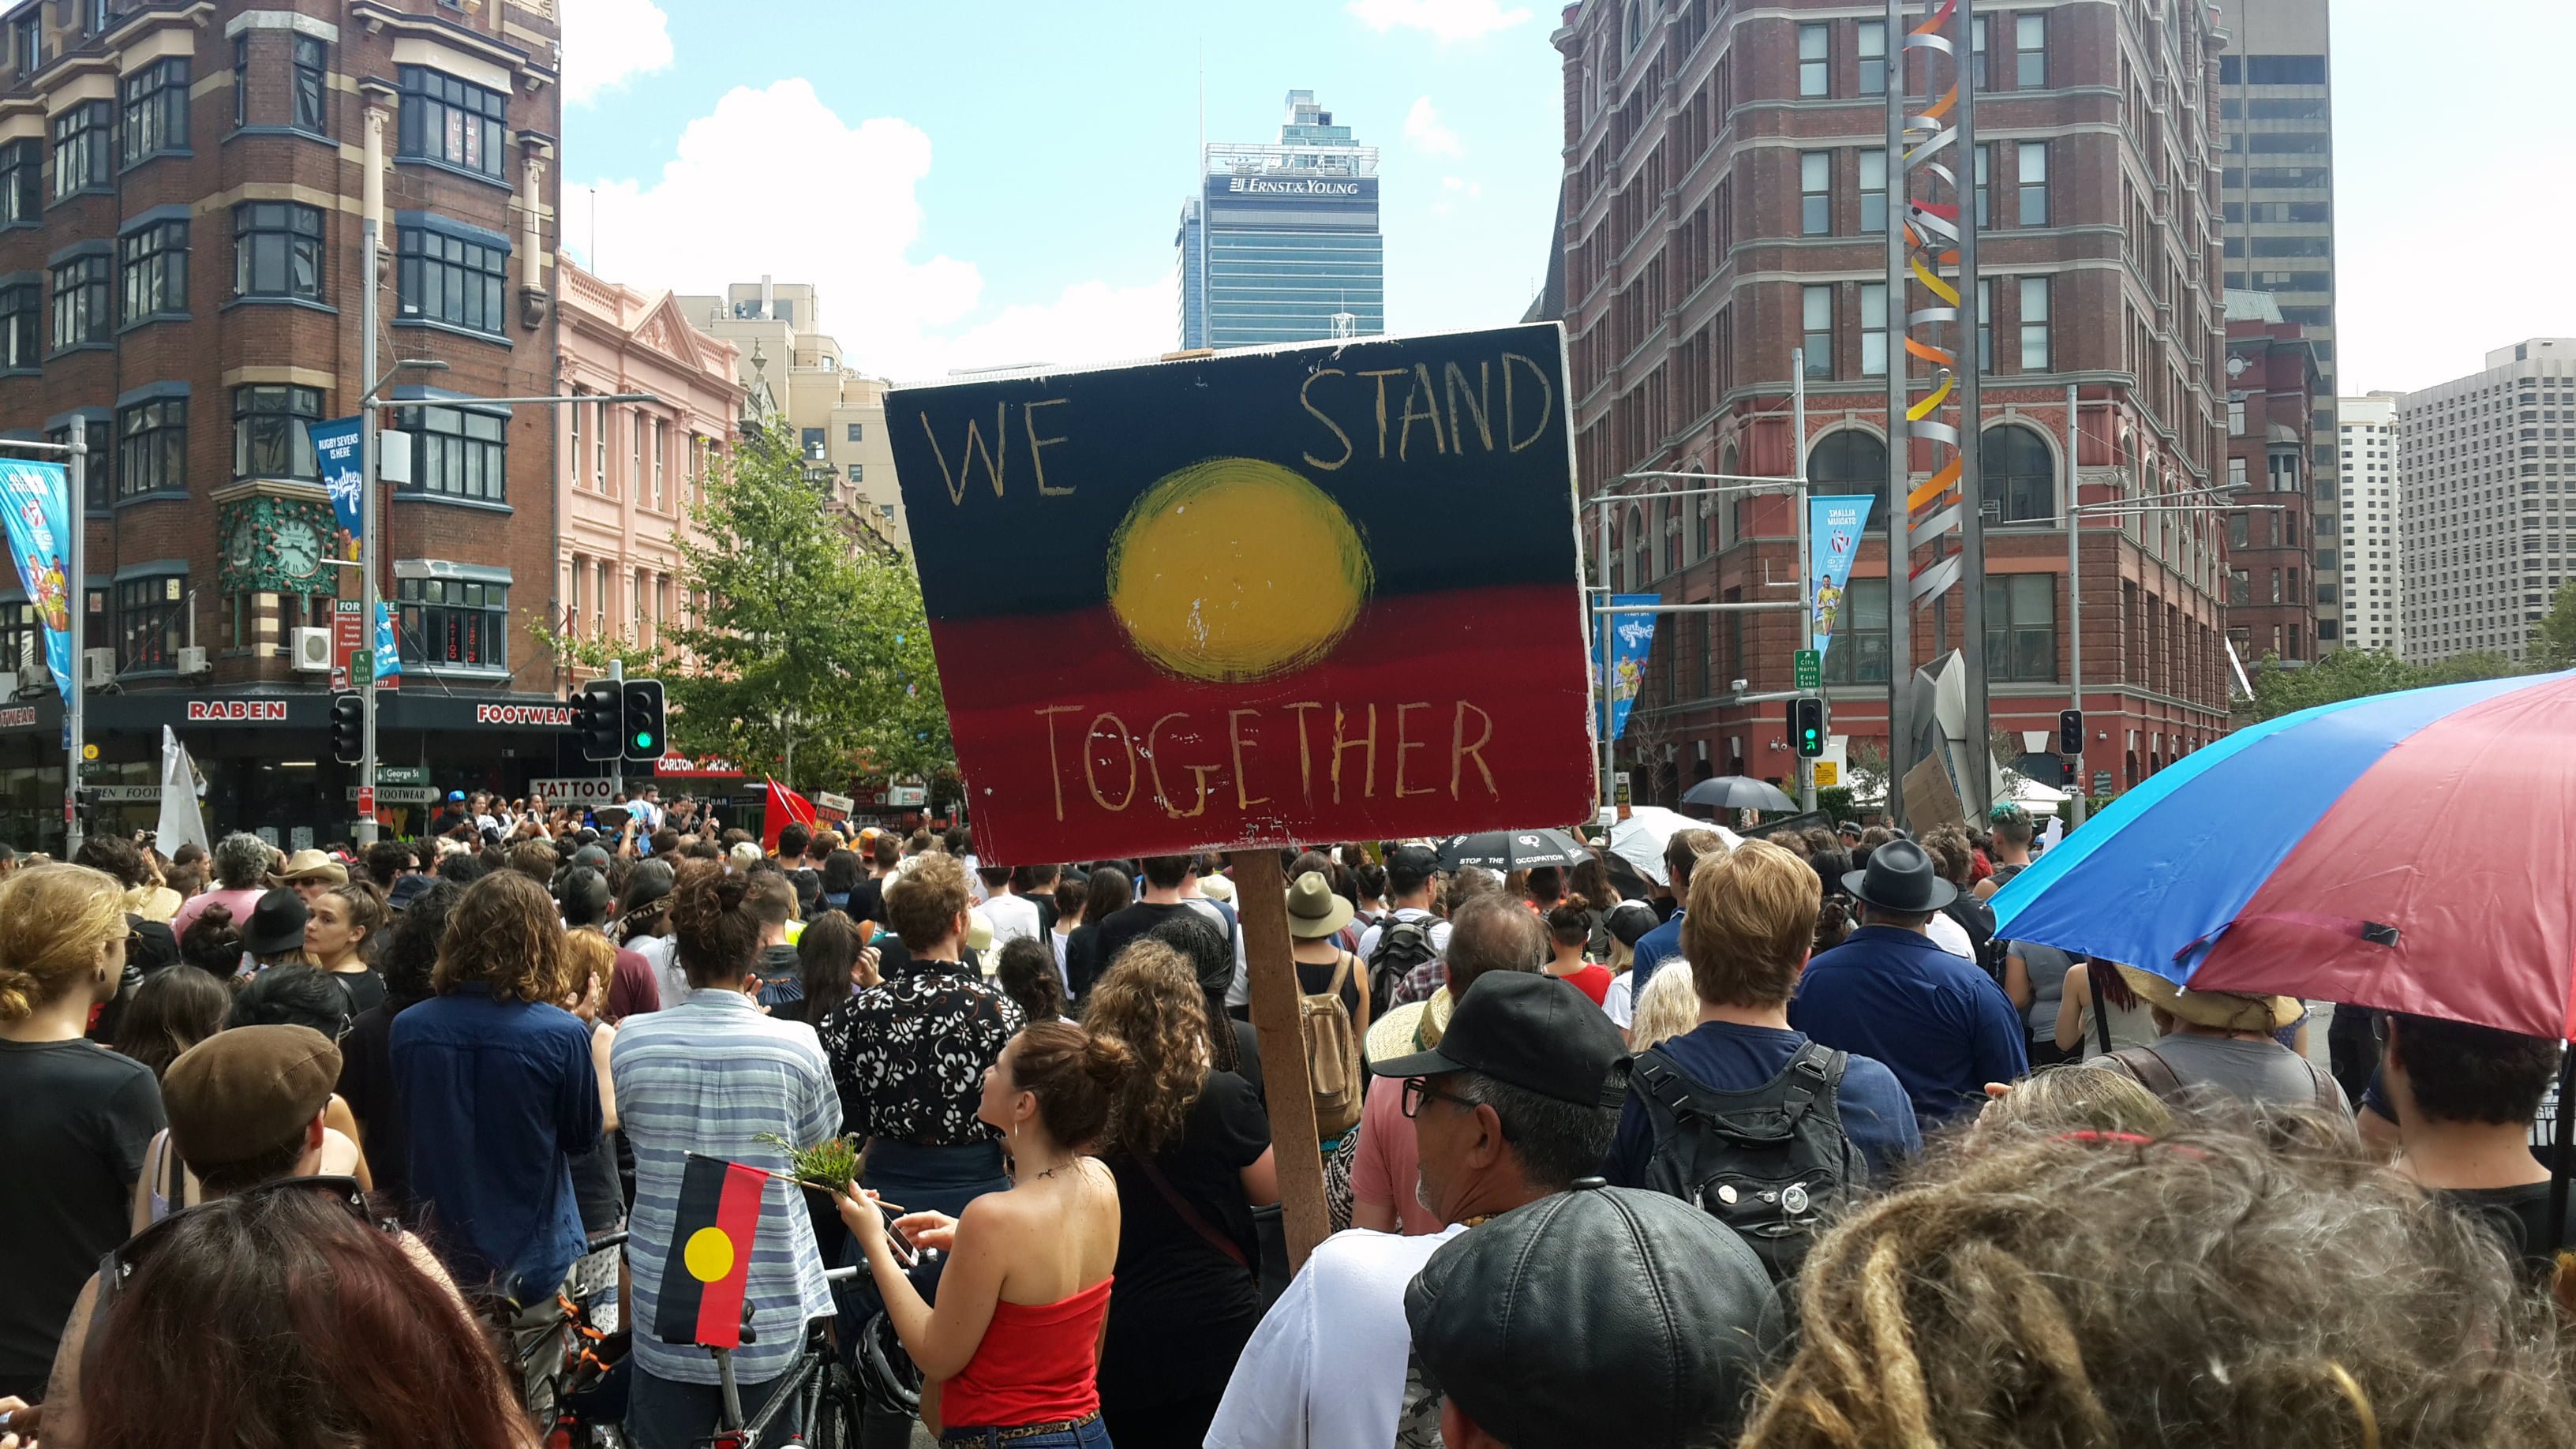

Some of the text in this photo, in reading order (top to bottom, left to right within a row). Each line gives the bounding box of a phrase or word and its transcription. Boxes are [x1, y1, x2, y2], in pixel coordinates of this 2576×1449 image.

[453, 122, 475, 137] LESE
[1249, 178, 1292, 193] ERNST
[1306, 179, 1358, 194] YOUNG
[920, 352, 1552, 506] WE STAND
[337, 433, 358, 447] SEVENS
[330, 447, 350, 459] IS HERE
[339, 601, 361, 611] FOR
[188, 701, 286, 721] RABEN
[658, 758, 694, 771] CARLTON
[1035, 699, 1500, 822] TOGETHER
[386, 769, 419, 780] George St
[380, 789, 425, 799] FOOTWEAR
[537, 781, 610, 797] TATTOO
[818, 807, 846, 822] STOP
[814, 819, 833, 830] BLA
[1515, 854, 1564, 864] OCCUPATION
